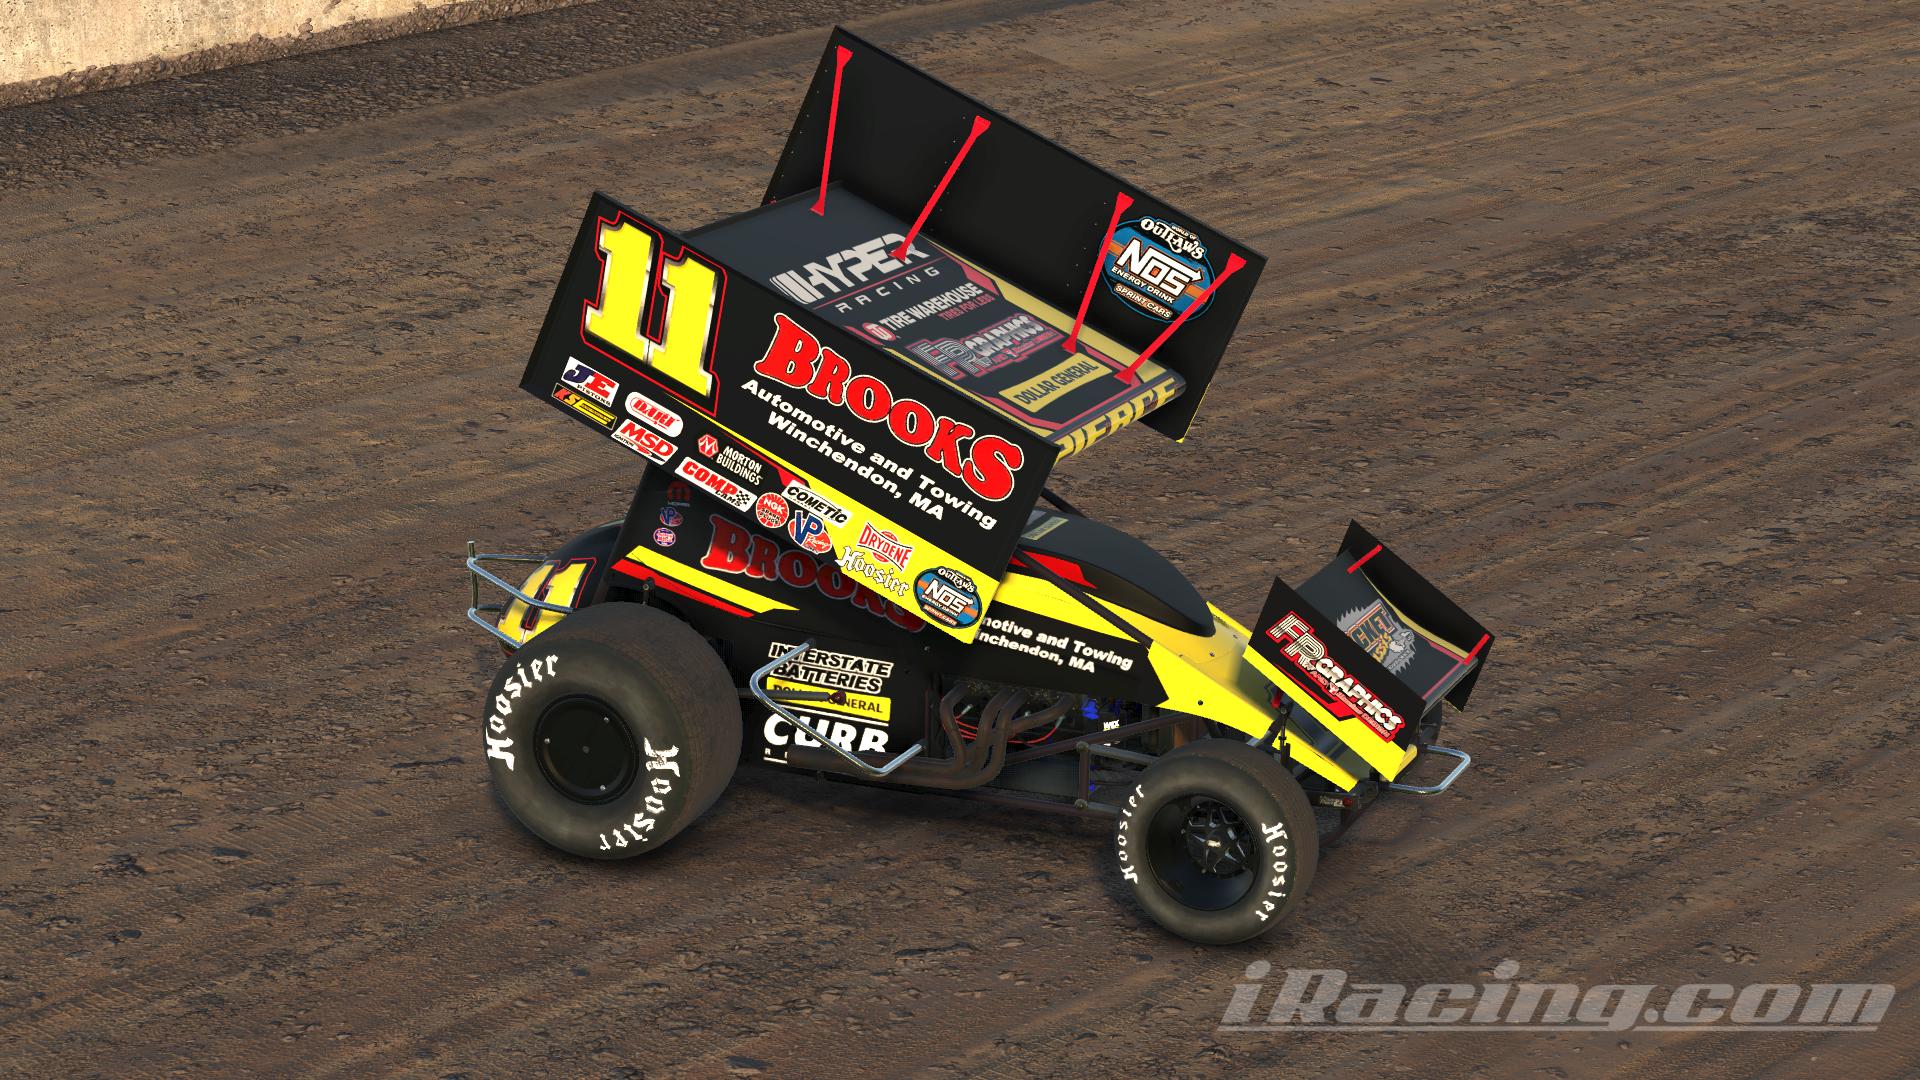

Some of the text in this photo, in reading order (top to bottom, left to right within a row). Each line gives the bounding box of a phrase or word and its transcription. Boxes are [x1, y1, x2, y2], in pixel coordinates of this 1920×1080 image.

[1141, 219, 1204, 259] OUTLAWS
[770, 233, 930, 304] HYPER
[1111, 266, 1175, 304] ENERGY DRINK
[1116, 238, 1203, 297] NOS
[583, 218, 716, 400] 11
[835, 267, 940, 313] RACING
[879, 308, 917, 331] TIRE
[909, 283, 984, 320] WAREHOUSE
[1115, 285, 1171, 318] SPRINT CARS
[563, 364, 616, 399] JE
[577, 384, 611, 406] PISTONS
[1013, 361, 1099, 405] DOLLAR GENERAL
[633, 399, 677, 428] DART
[754, 313, 1024, 501] BROOKS
[620, 421, 674, 457] MSD
[722, 446, 763, 474] MORTON
[741, 379, 997, 531] Automotive and Towing
[682, 461, 739, 495] COMP
[716, 453, 763, 486] BUILDINGS
[768, 411, 943, 521] Winchendon, MA
[715, 490, 743, 508] CAMS
[759, 512, 779, 525] PLUGS
[761, 507, 781, 521] SPARK
[764, 498, 785, 514] NGK
[795, 511, 823, 545] VP
[858, 525, 912, 568] DRYDENE
[835, 546, 909, 596] Hoosier
[925, 579, 973, 613] NOS
[975, 629, 1095, 673] inchendon, MA
[982, 616, 1134, 672] motive and Towing
[770, 663, 882, 694] BATTERIES
[1315, 658, 1402, 731] GRAPHICS
[485, 654, 559, 771] Hoosier
[600, 737, 681, 850] Hoosier
[1117, 784, 1145, 884] Hoosier
[1256, 822, 1288, 922] Hoosier
